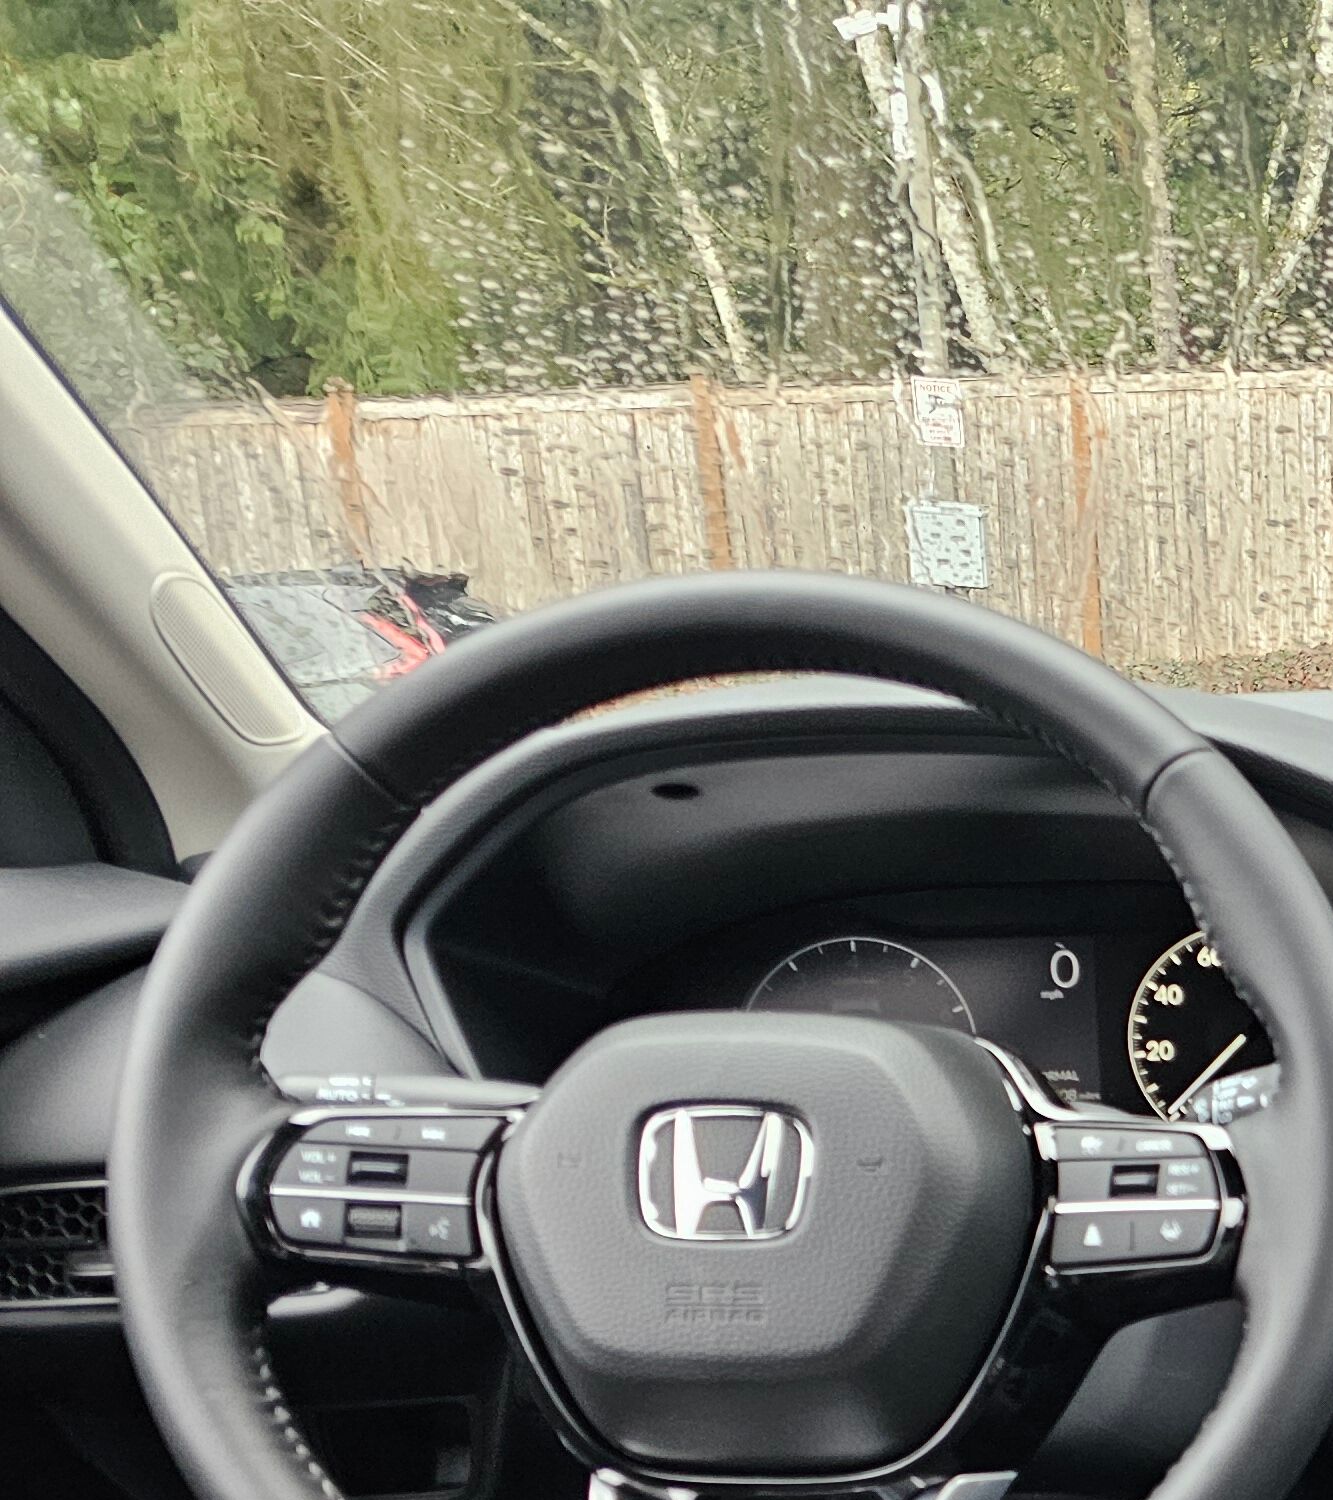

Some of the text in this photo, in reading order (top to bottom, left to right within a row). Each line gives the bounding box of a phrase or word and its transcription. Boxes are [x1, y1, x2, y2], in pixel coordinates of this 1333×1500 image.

[1051, 949, 1079, 988] 0
[1154, 984, 1184, 1005] 40
[1146, 1040, 1175, 1061] 20
